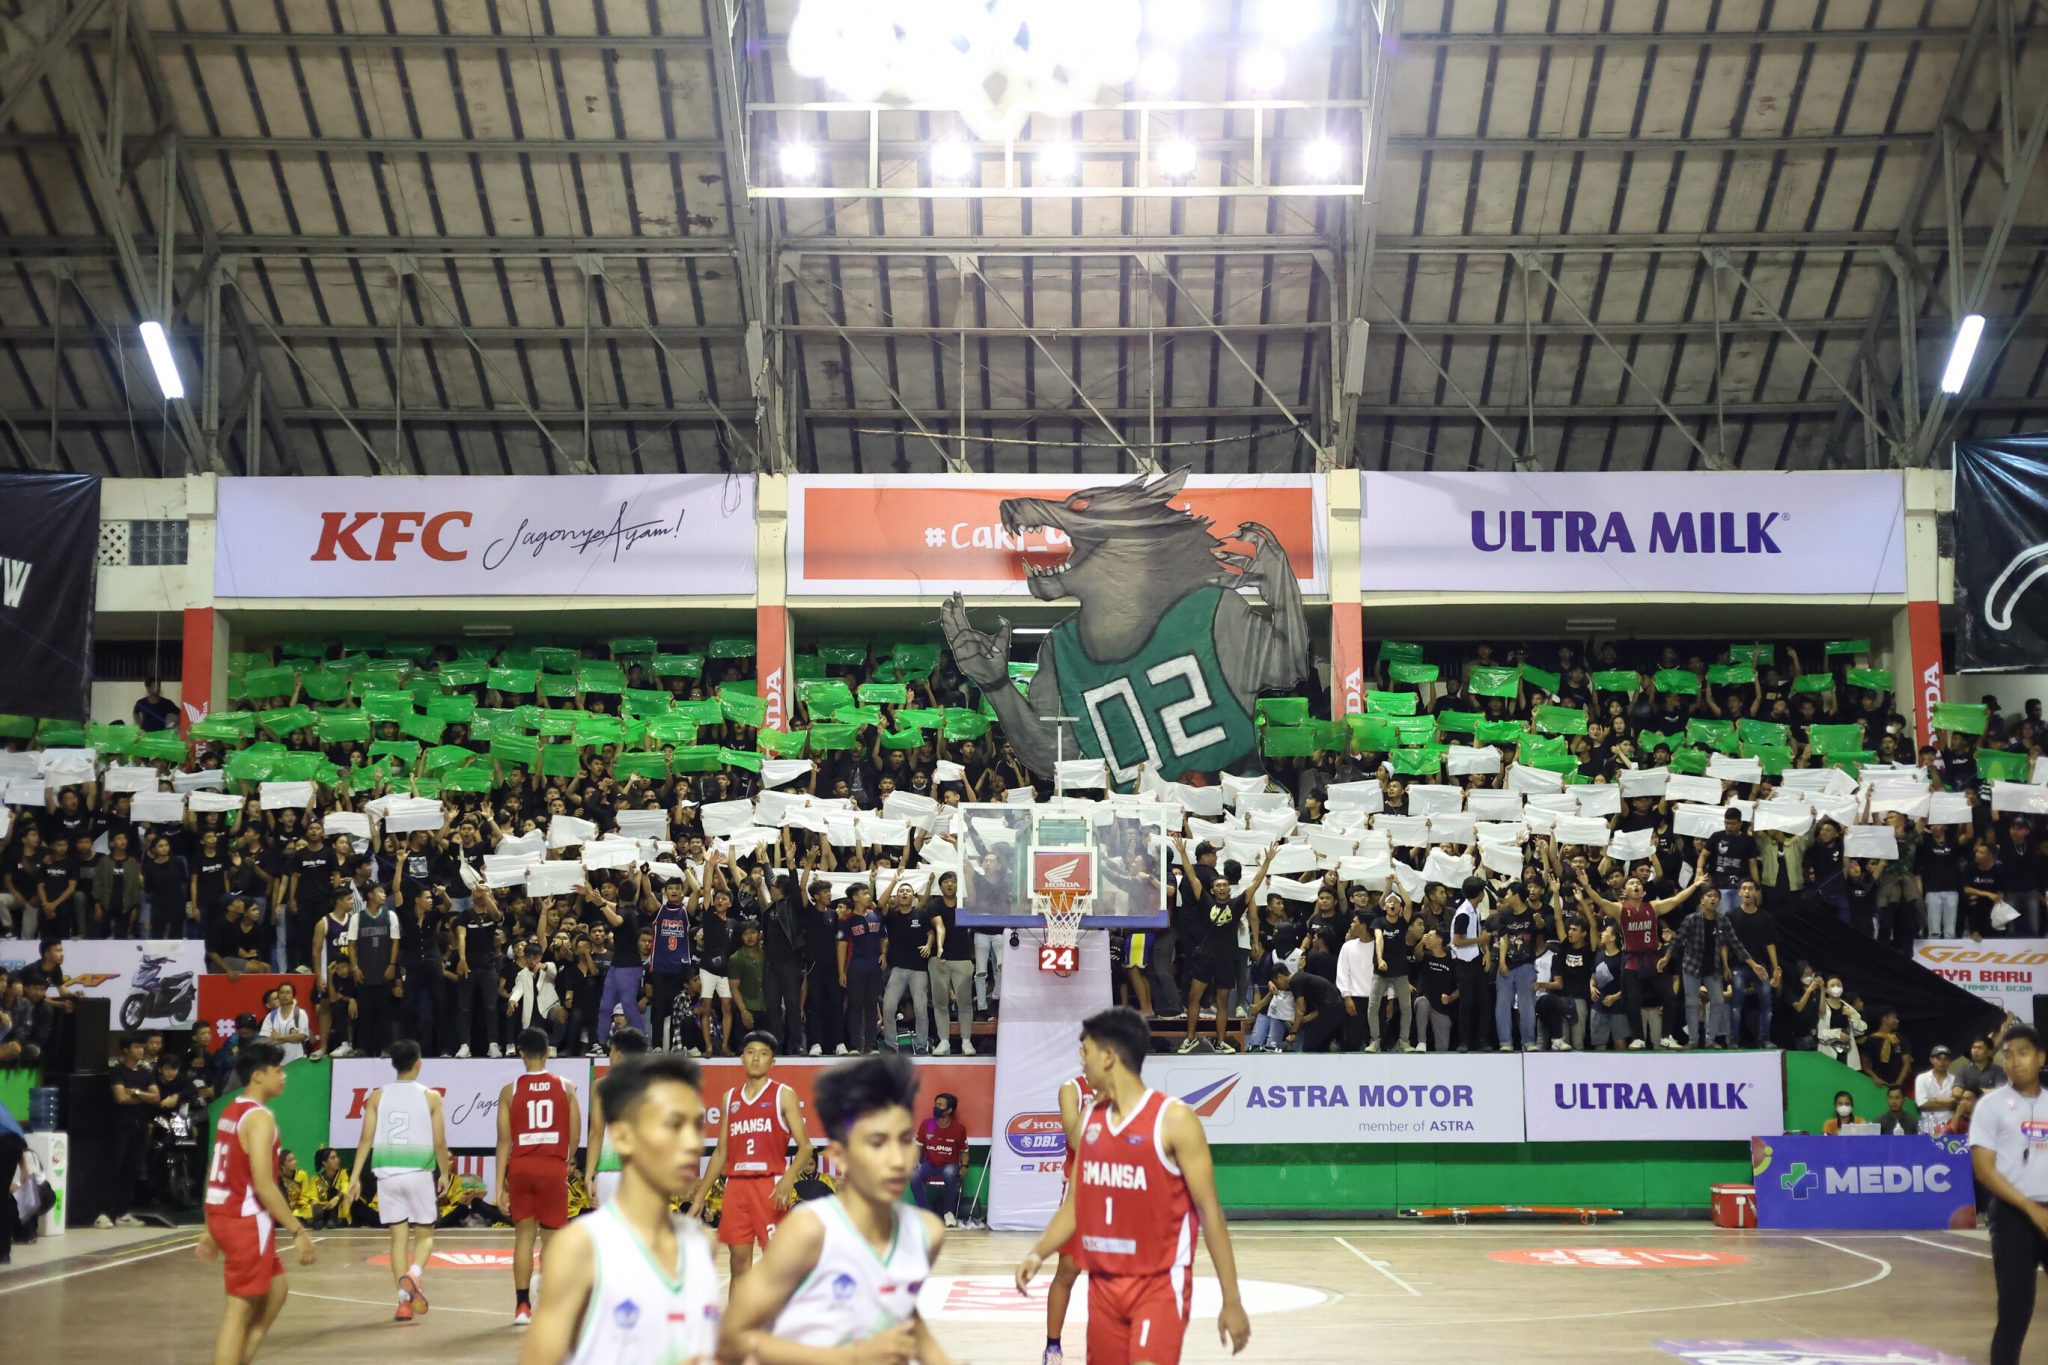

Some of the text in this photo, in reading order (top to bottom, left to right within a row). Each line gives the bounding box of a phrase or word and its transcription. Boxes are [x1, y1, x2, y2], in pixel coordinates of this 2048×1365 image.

[310, 511, 473, 561] KFC
[1471, 510, 1636, 553] ULTRA
[1083, 654, 1227, 785] 02
[1043, 881, 1081, 889] HONDA
[1628, 920, 1653, 931] MIAMI
[667, 936, 678, 951] 9
[1644, 931, 1651, 943] 6
[1041, 950, 1074, 970] 24
[1979, 970, 2033, 983] BARU
[529, 1081, 551, 1092] ALDO
[1246, 1084, 1474, 1108] ASTRA MOTOR
[1554, 1083, 1658, 1110] ULTRA
[526, 1099, 554, 1129] 10
[387, 1111, 410, 1146] 2
[1033, 1121, 1064, 1130] HON
[1358, 1120, 1475, 1132] member of ASTRA
[746, 1138, 755, 1155] 2
[1033, 1136, 1059, 1148] DBL
[1039, 1162, 1066, 1173] KF
[1825, 1164, 1952, 1194] MEDIC
[1105, 1196, 1113, 1226] 1
[1139, 1318, 1151, 1347] 1
